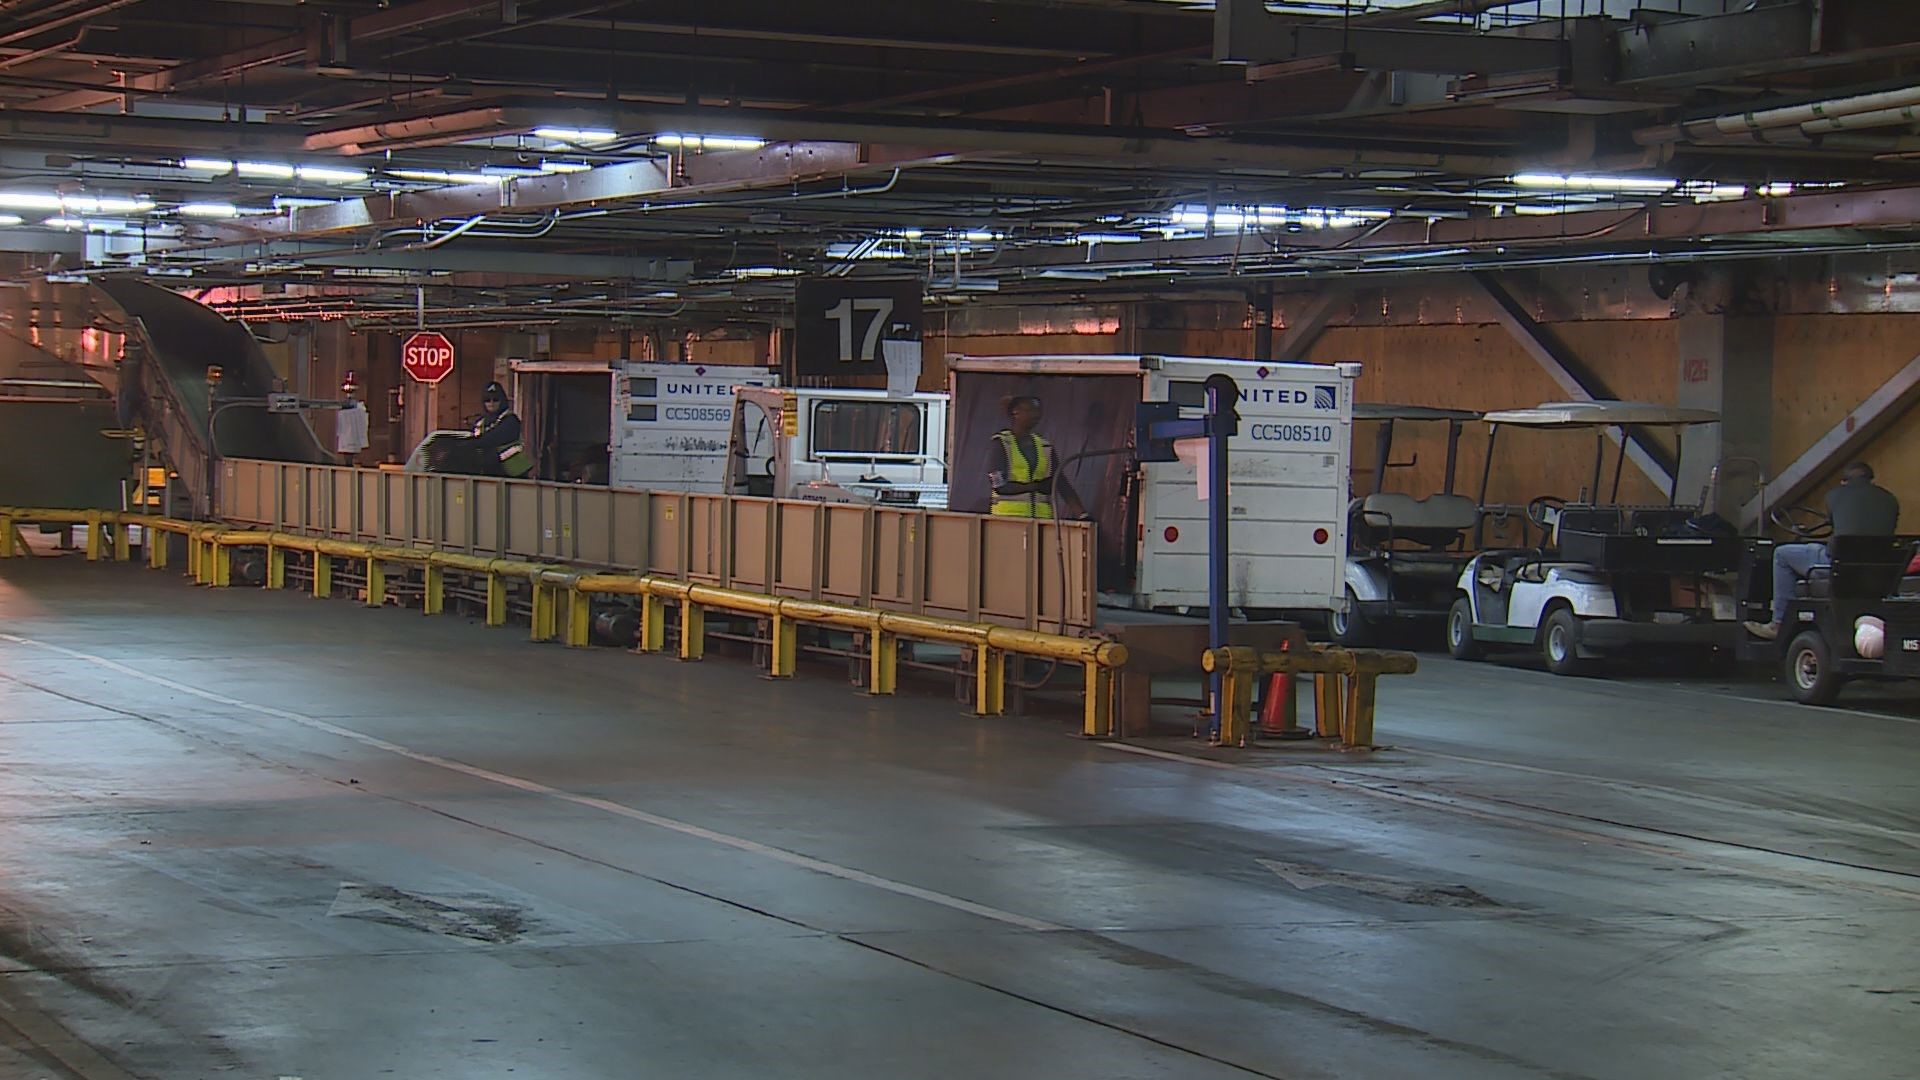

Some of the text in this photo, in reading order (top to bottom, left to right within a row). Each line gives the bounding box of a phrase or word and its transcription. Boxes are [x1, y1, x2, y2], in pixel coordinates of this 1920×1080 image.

[825, 298, 894, 361] 17
[406, 347, 450, 366] STOP
[1238, 389, 1308, 404] NITED
[665, 407, 731, 422] CC508569
[1251, 424, 1332, 442] CC508510
